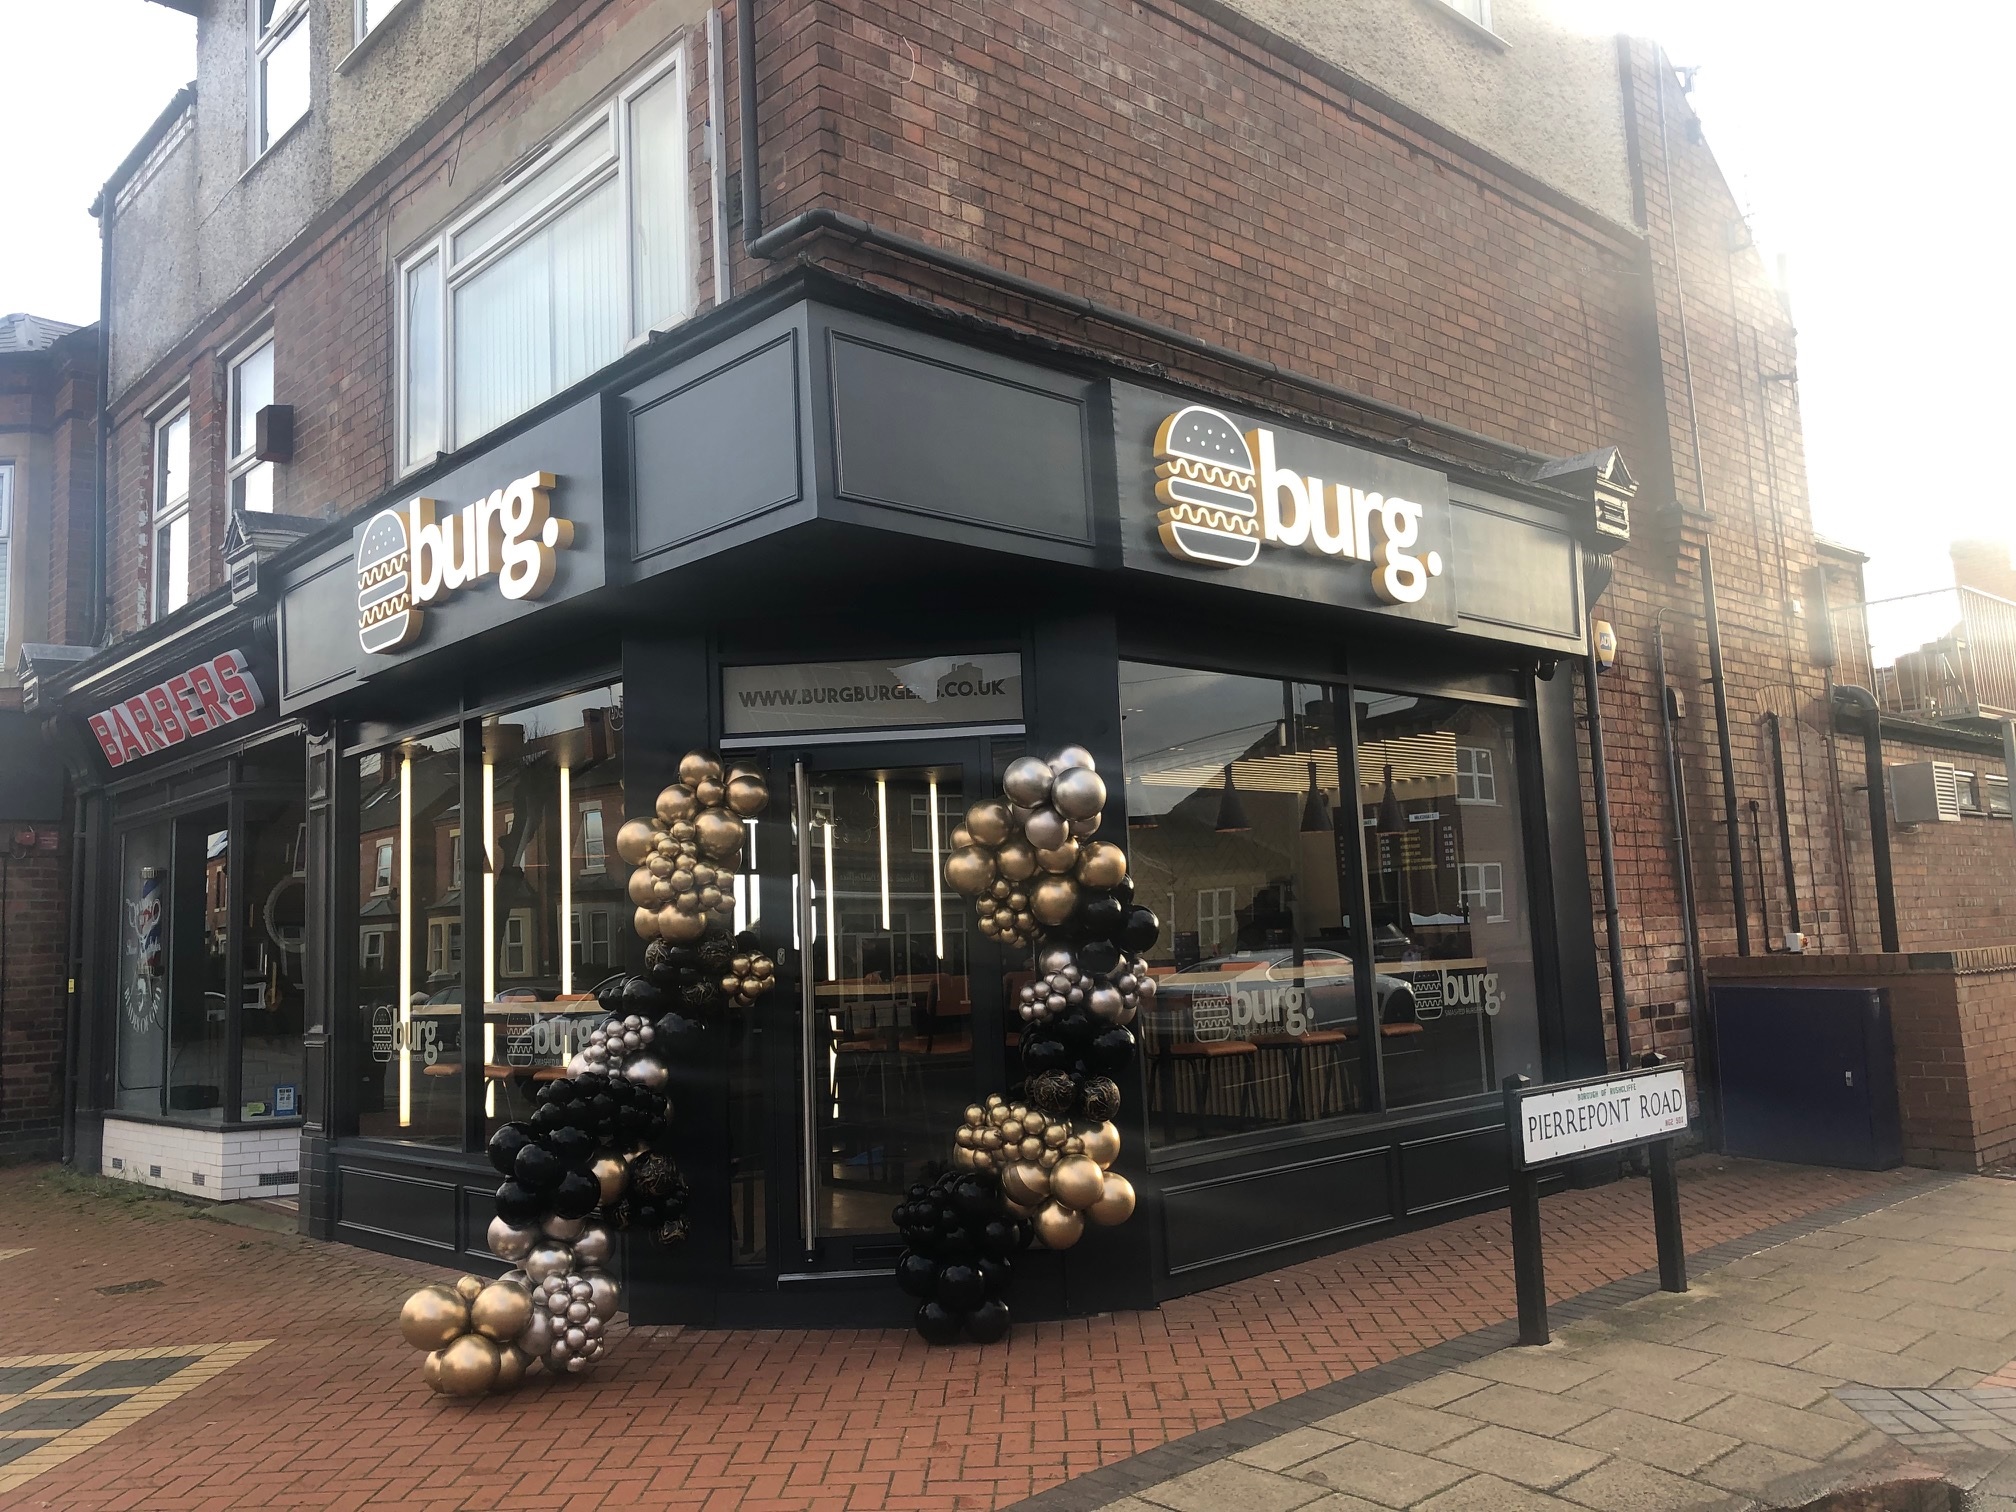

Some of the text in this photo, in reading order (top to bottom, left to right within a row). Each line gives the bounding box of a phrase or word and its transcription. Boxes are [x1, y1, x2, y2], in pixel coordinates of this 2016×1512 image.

[409, 470, 564, 606] burg.
[1258, 428, 1442, 603] burg.
[88, 651, 258, 768] BARBERS
[738, 678, 1006, 708] WWW.BURGBURGE.CO.UK
[1230, 977, 1315, 1036] burg.
[1441, 962, 1506, 1016] burg.
[392, 1007, 444, 1066] burg.
[1528, 1088, 1683, 1143] PIERREPONT ROAD
[1577, 1082, 1637, 1101] BOROUGH OF RUSHCLIFFE
